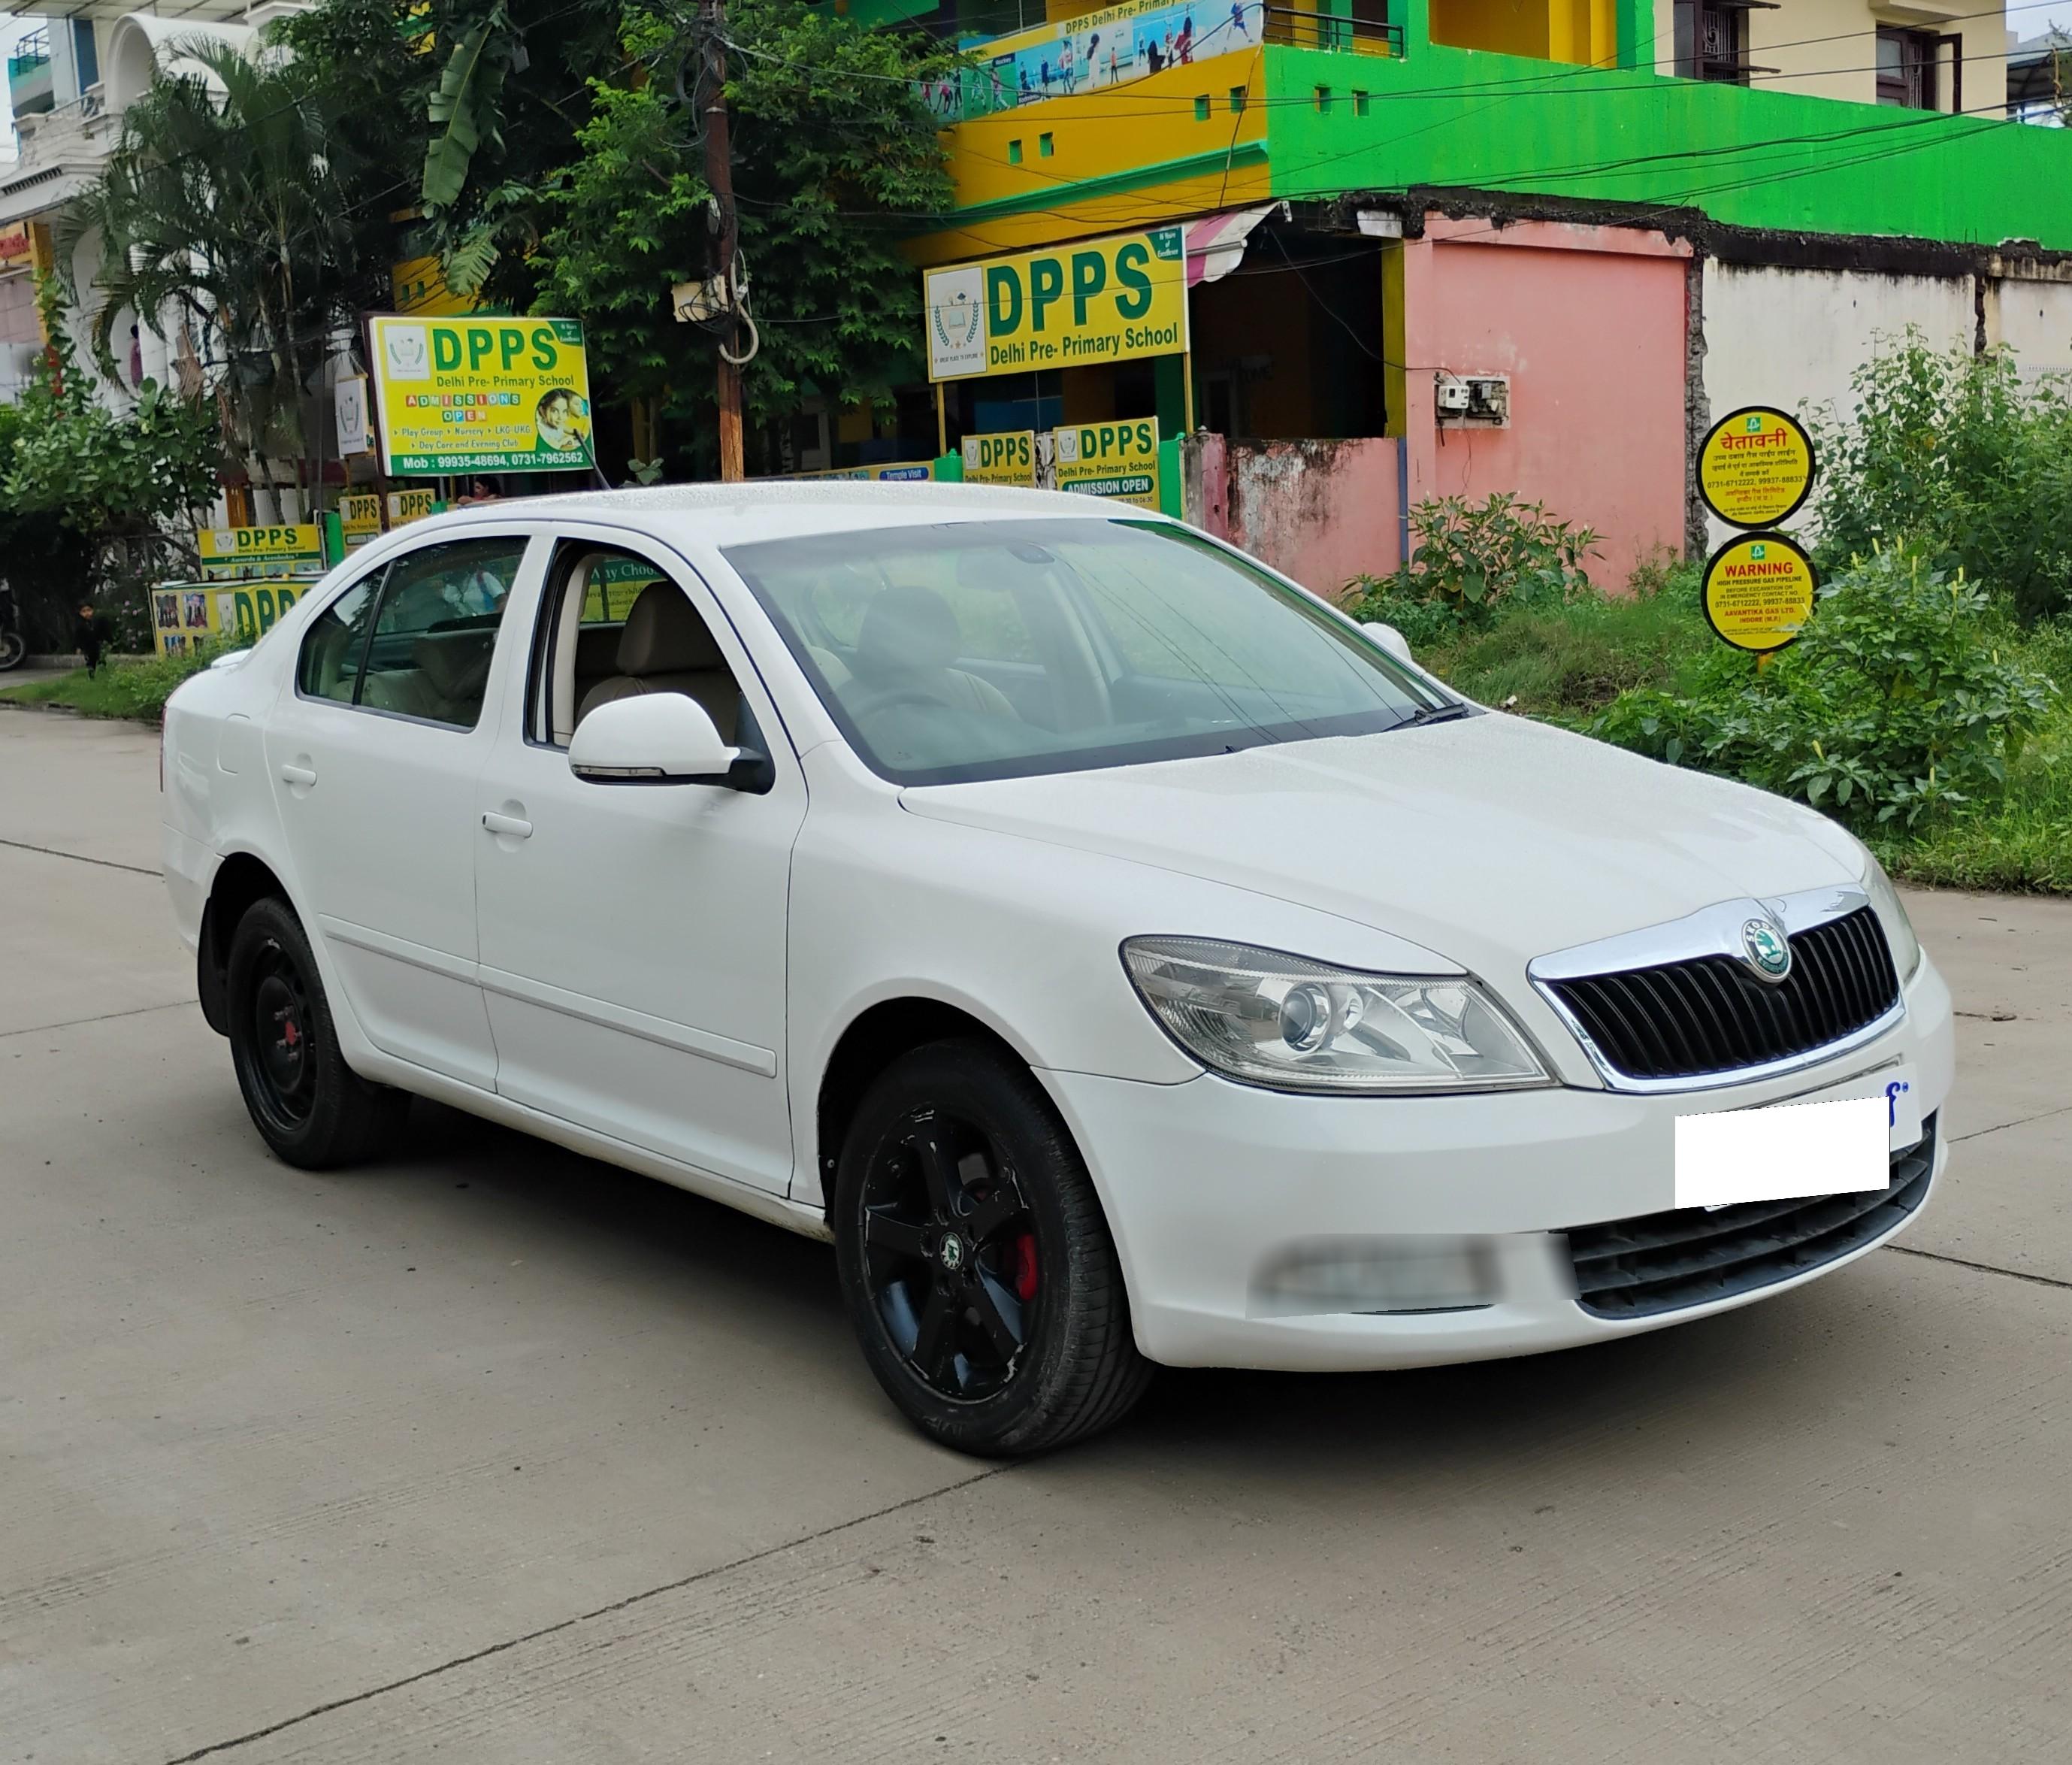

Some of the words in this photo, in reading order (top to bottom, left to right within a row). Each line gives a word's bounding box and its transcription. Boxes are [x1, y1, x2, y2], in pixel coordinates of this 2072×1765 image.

[1066, 18, 1089, 35] DPPS
[1092, 11, 1115, 26] Delhi
[1118, 8, 1136, 20] Pre-
[1139, 0, 1175, 12] Prima
[987, 243, 1153, 338] DPPS
[433, 328, 558, 371] DPPS
[991, 344, 1024, 365] Delhi
[1030, 341, 1058, 361] Pre-
[1063, 333, 1120, 357] Primary
[1125, 322, 1178, 349] School
[437, 377, 464, 387] Delhi
[468, 377, 490, 387] Pre-
[494, 376, 534, 389] Primary
[539, 375, 574, 386] School
[407, 394, 521, 407] ADMISSIONS
[442, 410, 487, 422] OPEN
[402, 428, 419, 437] Play
[421, 427, 443, 436] Group
[455, 427, 483, 436] Nursery
[1720, 428, 1788, 450] चेतावनी
[419, 440, 433, 450] Day
[455, 440, 470, 448] and
[471, 439, 501, 450] Evening
[503, 439, 518, 447] Club
[1081, 423, 1153, 459] DPPS
[981, 436, 1030, 468] DPPS
[404, 457, 428, 469] Mob
[438, 455, 510, 468] 99935-48694,
[512, 453, 583, 465] 0731-7962562
[1058, 468, 1077, 477] Delhi
[1079, 466, 1094, 476] Pre-
[1097, 465, 1127, 474] Primary
[1129, 460, 1155, 471] School
[909, 469, 921, 478] Visit
[991, 474, 1012, 484] Primary
[1013, 472, 1032, 482] School
[1068, 481, 1120, 495] ADMISSION
[1122, 478, 1148, 492] OPEN
[349, 497, 377, 519] DPPS
[401, 493, 433, 516] DPPS
[237, 528, 298, 547] DPPS
[1725, 562, 1793, 577] WARNING
[234, 589, 310, 644] DPP
[1724, 608, 1763, 616] AAVANTIKA
